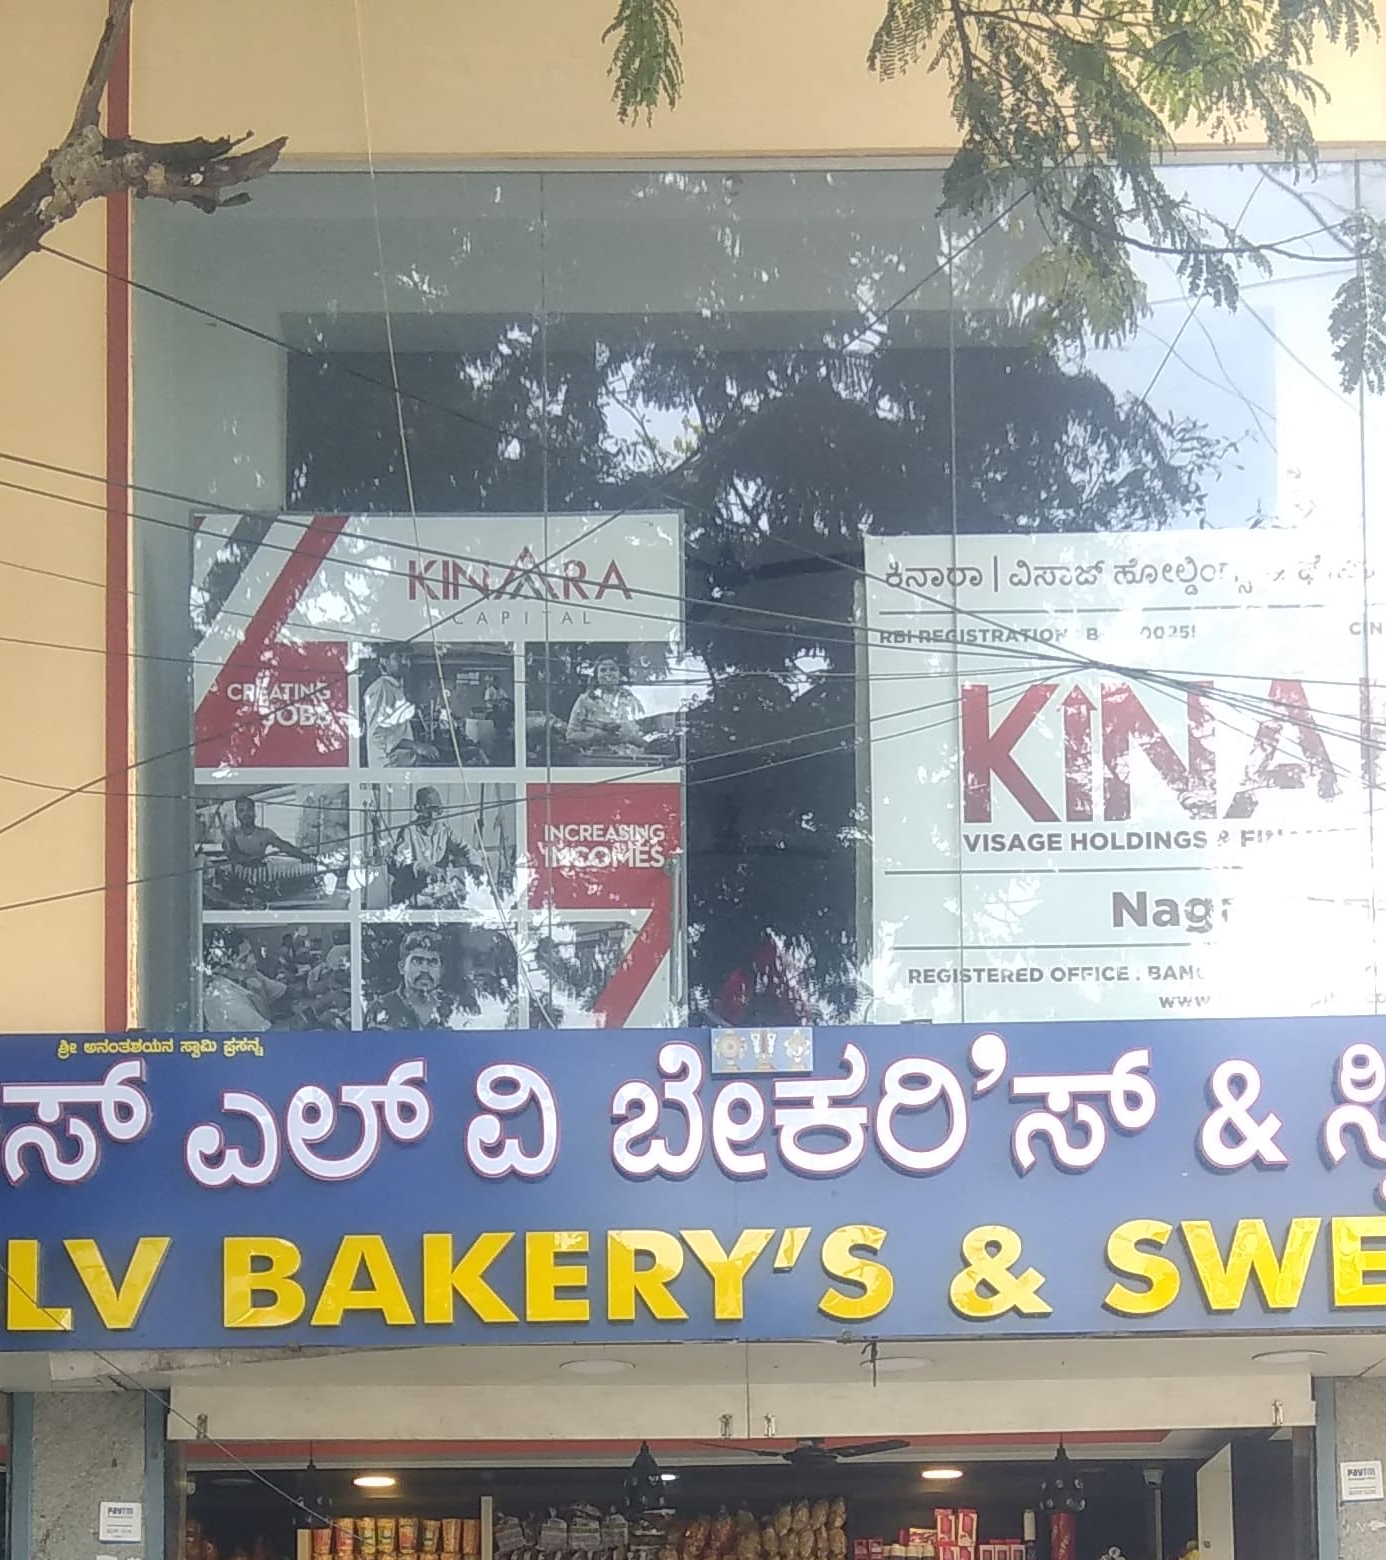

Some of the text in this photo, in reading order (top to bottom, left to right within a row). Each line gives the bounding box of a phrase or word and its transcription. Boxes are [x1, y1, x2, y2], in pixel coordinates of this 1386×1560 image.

[409, 546, 633, 601] KINARA
[453, 611, 592, 625] CAPITAL
[879, 630, 913, 644] RBI
[1349, 621, 1384, 636] CN
[227, 682, 331, 701] CREATING
[261, 703, 332, 726] JOBS
[544, 823, 666, 841] INCREASING
[963, 832, 1063, 854] VISAGE
[1069, 830, 1207, 852] HOLDINGS
[544, 845, 666, 868] INCOMES
[907, 968, 1044, 985] REGISTERED
[1050, 966, 1130, 983] OFFICE
[58, 1038, 78, 1059] ಶ್ರೀ
[185, 1057, 433, 1188] ಎಲ್
[465, 1056, 560, 1181] ವಿ
[1200, 1057, 1288, 1171] &
[222, 1223, 895, 1332] BAKERY'S
[948, 1224, 1054, 1320] &
